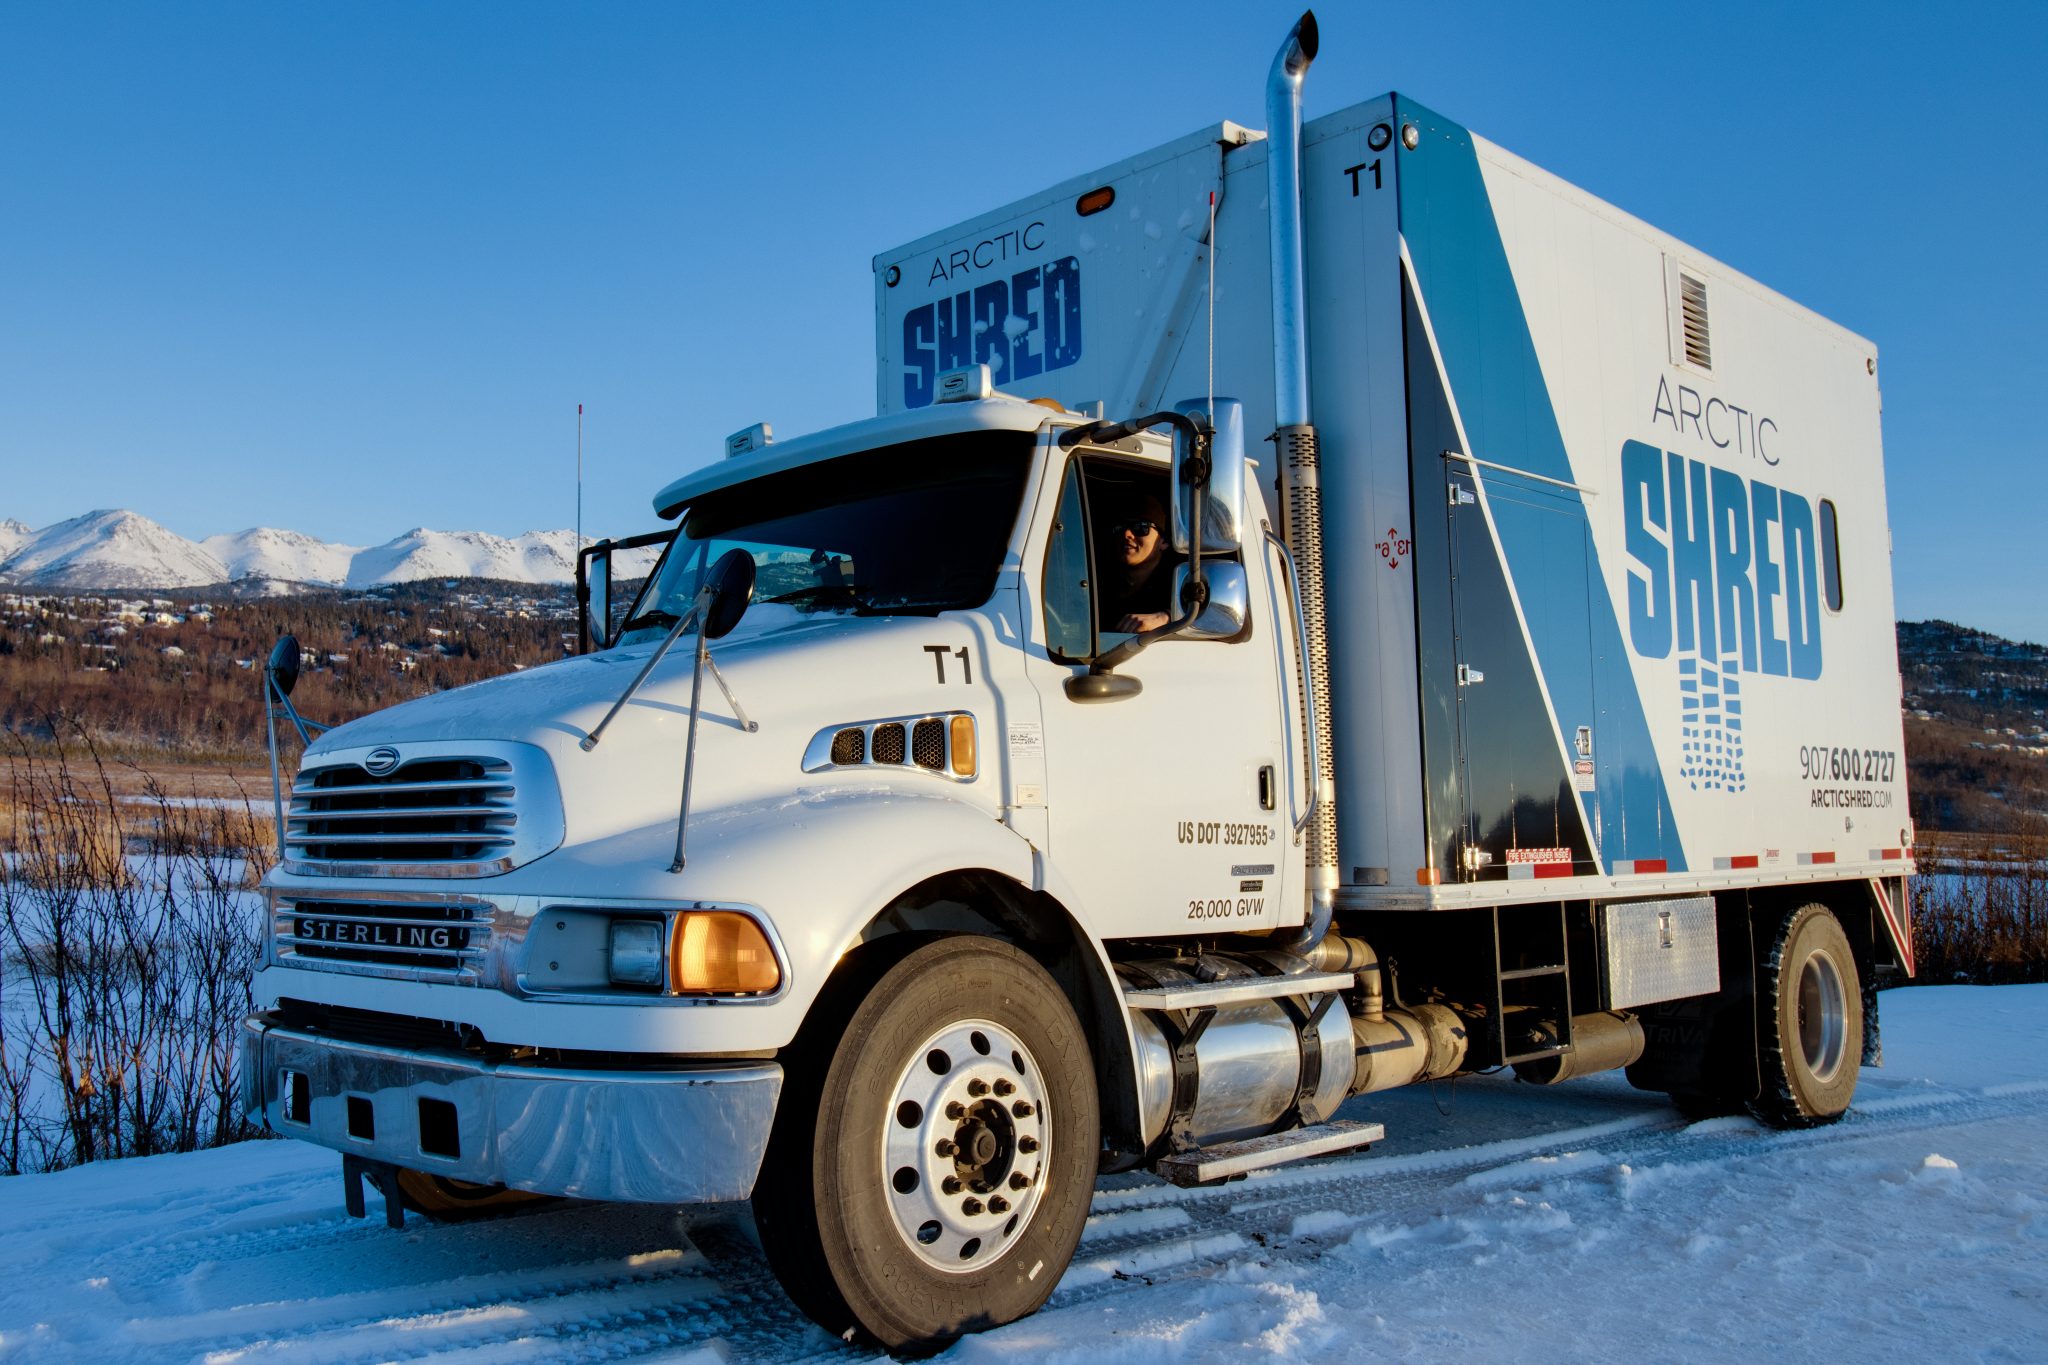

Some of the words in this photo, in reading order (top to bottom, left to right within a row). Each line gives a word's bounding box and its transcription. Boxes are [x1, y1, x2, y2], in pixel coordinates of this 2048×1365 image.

[1344, 159, 1382, 197] T1
[929, 222, 1046, 287] ARCTIC
[903, 255, 1081, 408] SHRED
[1653, 374, 1780, 466] ARCTIC
[1621, 438, 1823, 681] SHRED
[923, 645, 973, 685] T1
[1800, 745, 1895, 783] 907.600.2727
[1811, 789, 1893, 808] ARCTICSHRED.COM
[1178, 821, 1194, 844] US
[1197, 822, 1221, 845] DOT
[1224, 823, 1268, 846] 3927955
[1188, 899, 1232, 922] 26,000
[1236, 898, 1265, 917] GVW
[303, 919, 449, 946] STERLING
